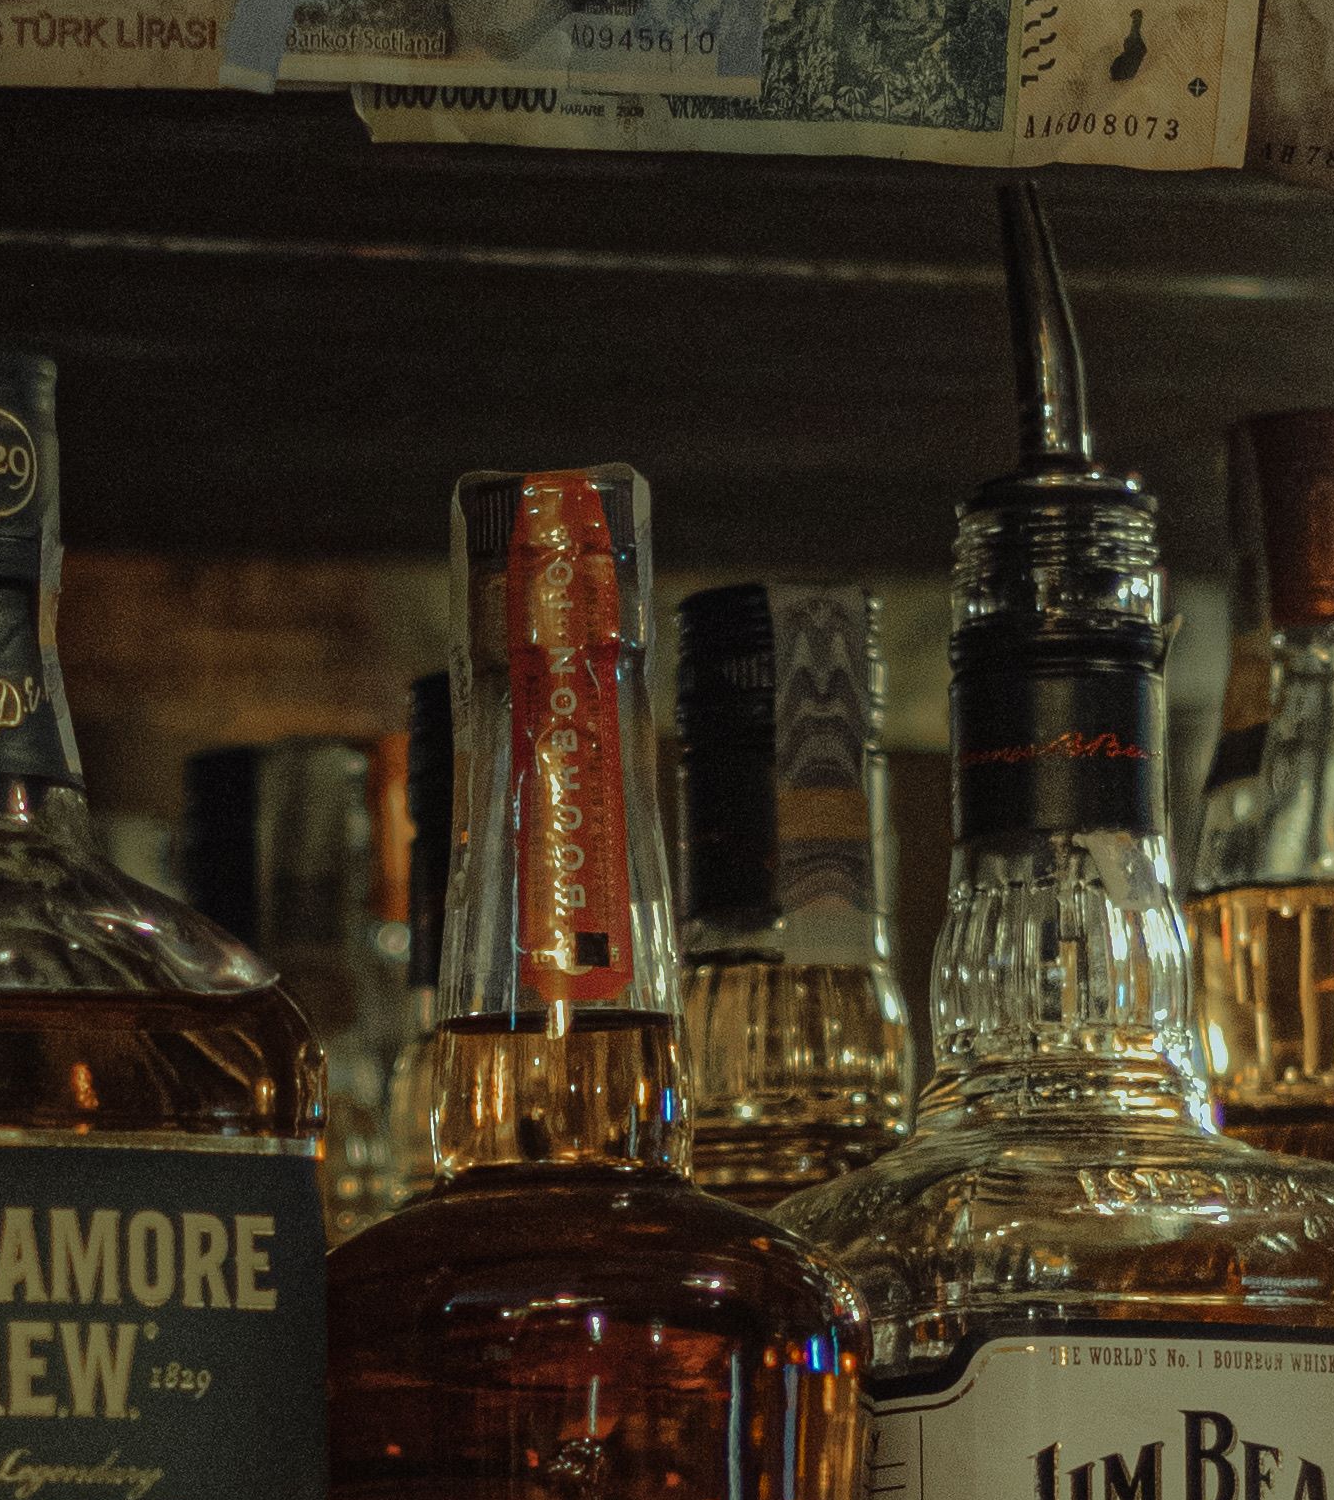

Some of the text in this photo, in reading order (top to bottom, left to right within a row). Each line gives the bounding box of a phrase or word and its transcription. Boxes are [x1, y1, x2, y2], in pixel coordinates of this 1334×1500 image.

[11, 8, 111, 50] TÜRK
[336, 26, 446, 54] of Scotland
[547, 645, 587, 909] BOURBON
[1087, 1346, 1159, 1369] WORLD'S
[1166, 1348, 1192, 1370] No.
[1213, 1348, 1285, 1373] BOURBON
[148, 1360, 213, 1400] 1829
